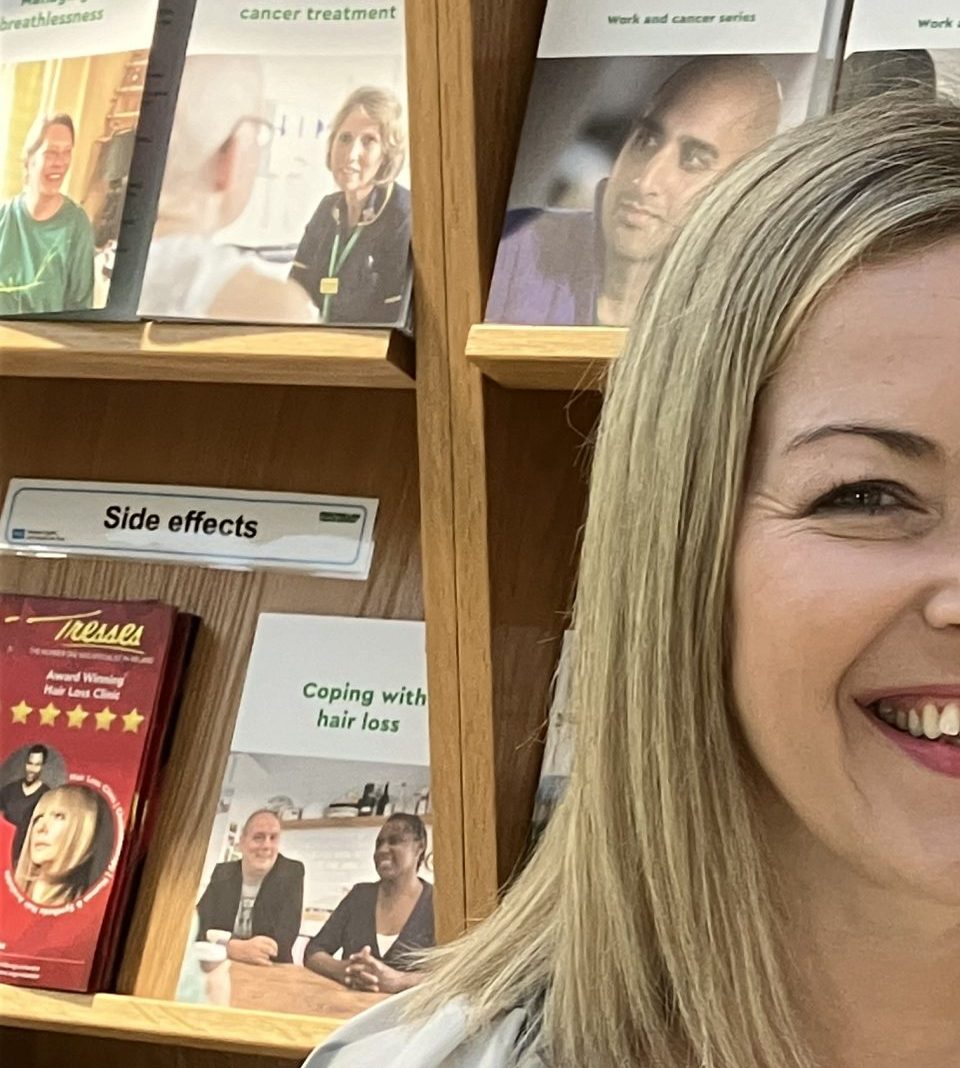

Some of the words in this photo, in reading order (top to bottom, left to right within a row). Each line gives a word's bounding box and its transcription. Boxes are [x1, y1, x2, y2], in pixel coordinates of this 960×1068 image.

[0, 8, 105, 32] breathlessness
[239, 8, 302, 21] cancer
[306, 5, 397, 21] treatment
[607, 13, 640, 25] Work
[643, 13, 669, 24] and
[671, 15, 717, 24] cancer
[718, 11, 756, 24] series
[918, 16, 953, 29] Work
[103, 505, 161, 532] Side
[168, 509, 259, 539] effects
[26, 610, 145, 647] Tresses
[45, 669, 82, 683] Award
[82, 671, 126, 688] Winning
[43, 683, 67, 696] Hair
[67, 686, 91, 698] Loss
[92, 687, 121, 701] Clinic
[302, 681, 375, 707] Coping
[382, 686, 426, 707] with
[316, 708, 357, 730] hair
[361, 711, 400, 733] loss
